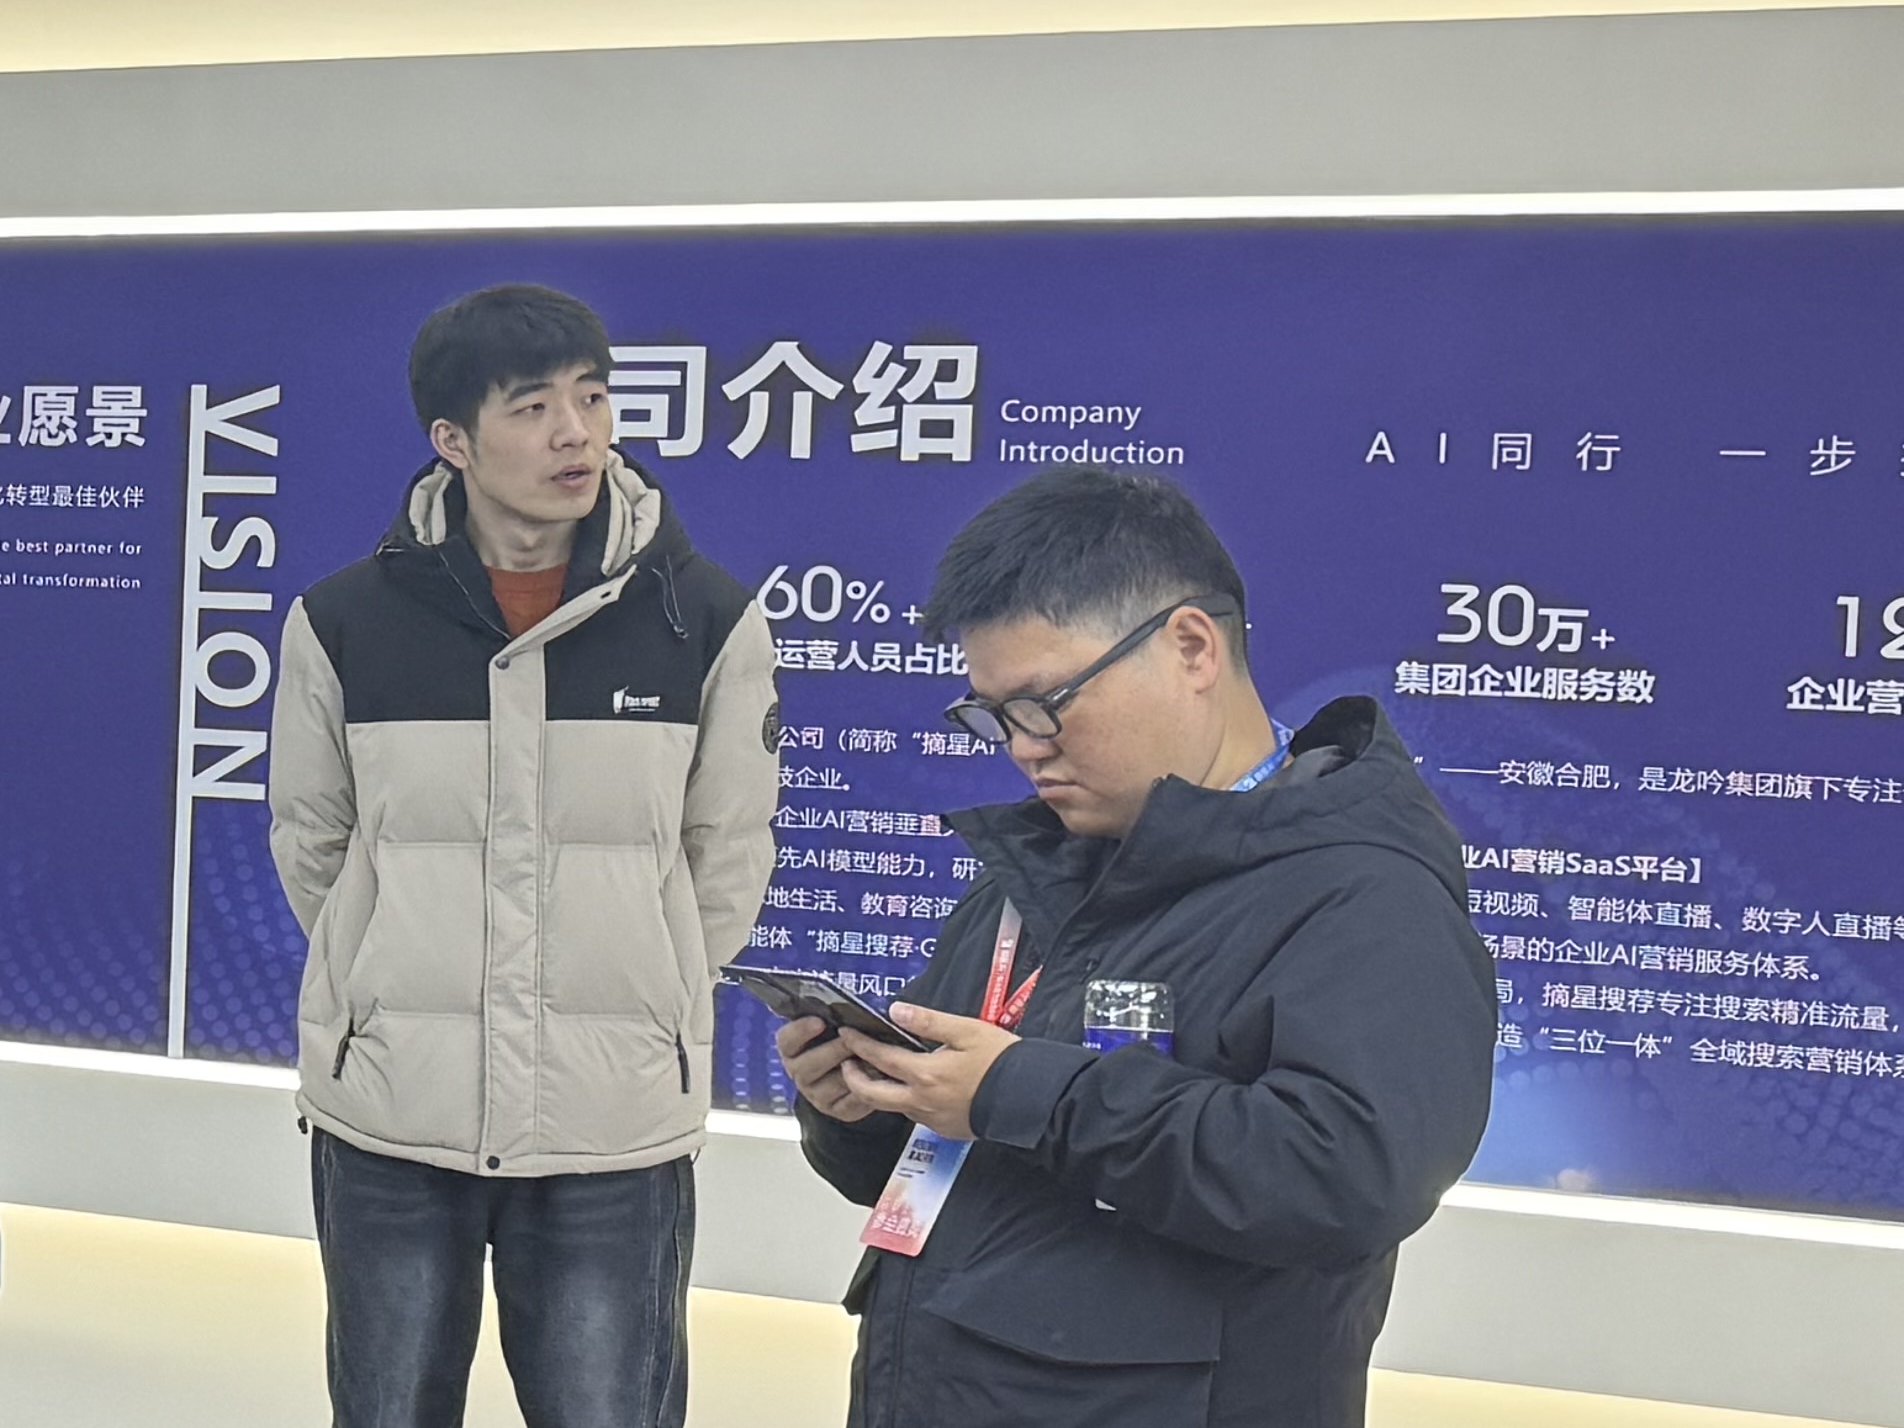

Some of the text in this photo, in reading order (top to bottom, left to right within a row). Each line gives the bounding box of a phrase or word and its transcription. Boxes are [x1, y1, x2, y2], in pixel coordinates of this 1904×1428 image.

[608, 340, 980, 463] 司介绍
[999, 398, 1142, 432] Company
[998, 437, 1185, 466] Introduction
[1719, 433, 1904, 476] 一步
[15, 538, 49, 554] best
[54, 541, 114, 557] partner
[119, 541, 143, 556] for
[21, 572, 142, 590] transformation
[193, 384, 281, 801] VISION
[1394, 659, 1657, 706] 集团企业服务数
[774, 805, 956, 837] 企业AI营销垂直
[773, 845, 986, 882] 先AI模型能力，研
[764, 885, 959, 920] 地生活、教育咨询
